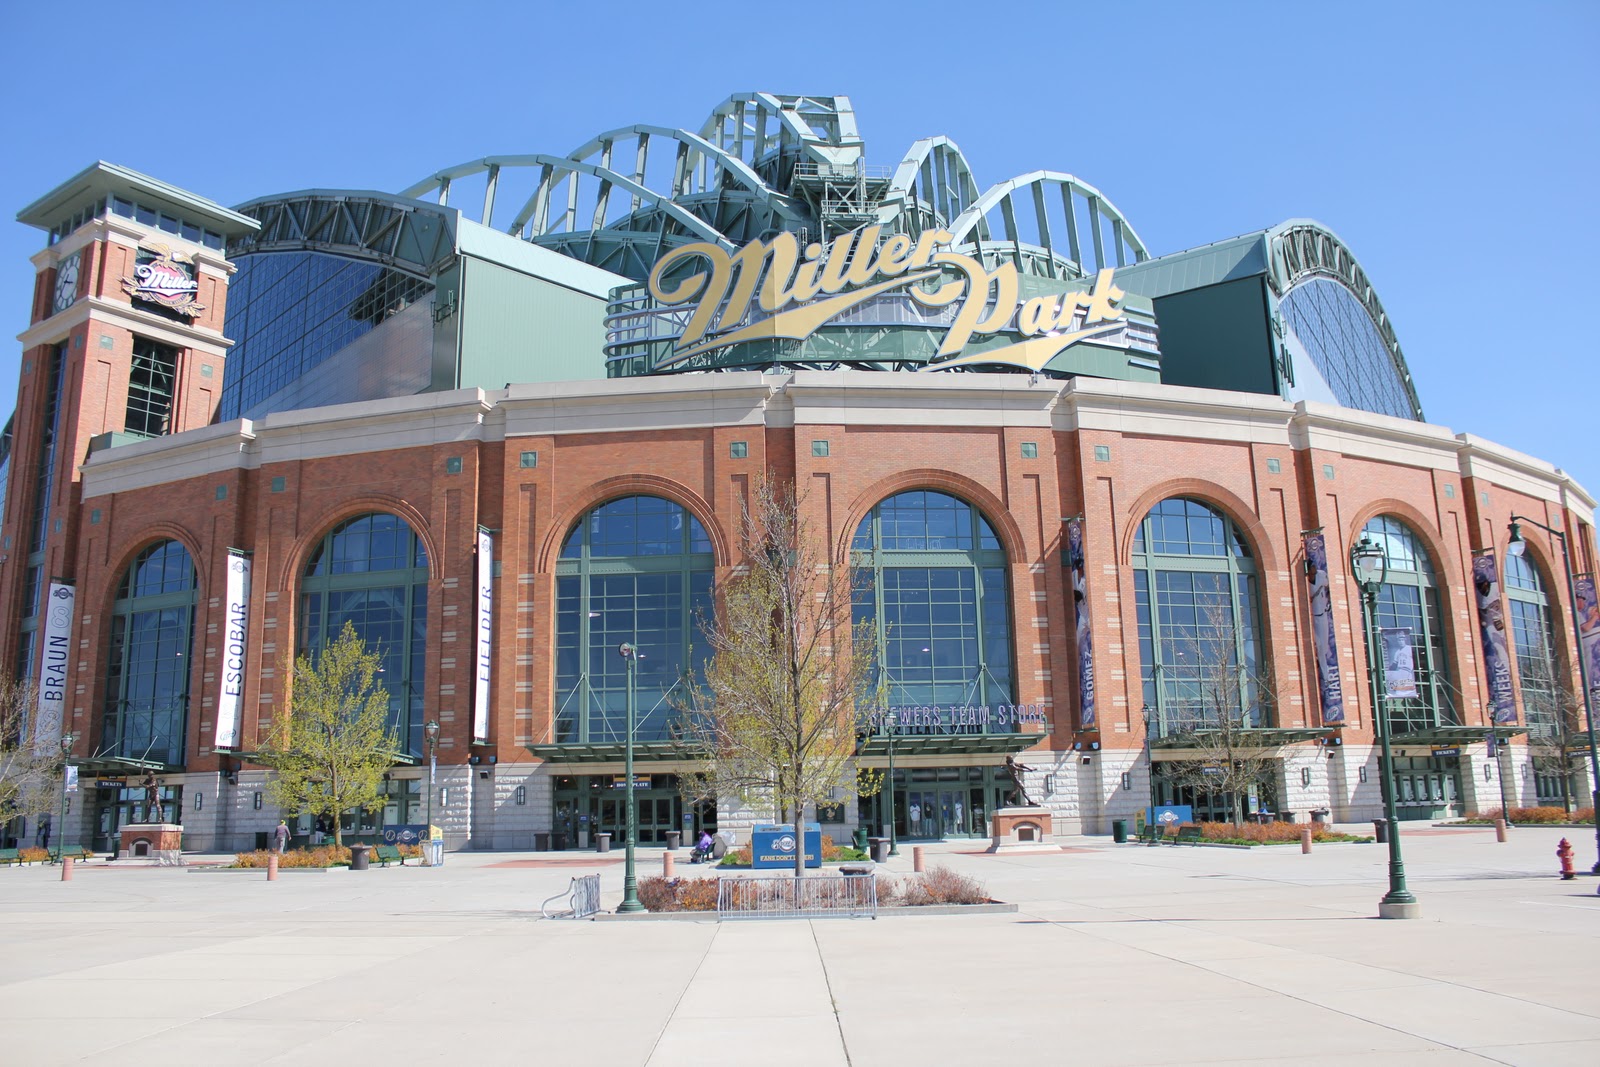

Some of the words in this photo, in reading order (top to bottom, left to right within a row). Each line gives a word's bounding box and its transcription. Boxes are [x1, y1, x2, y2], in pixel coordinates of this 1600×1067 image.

[137, 265, 198, 290] Miller
[648, 224, 956, 350] Miller
[908, 251, 1126, 359] Park
[225, 602, 247, 697] ESCOBAR
[480, 585, 492, 683] FIELDER
[45, 635, 69, 701] BRAUN
[1085, 650, 1095, 701] GOMEZ
[1327, 664, 1342, 700] HART
[1494, 660, 1513, 703] WEEKS
[949, 705, 991, 726] TEAM
[998, 703, 1046, 726] STORE
